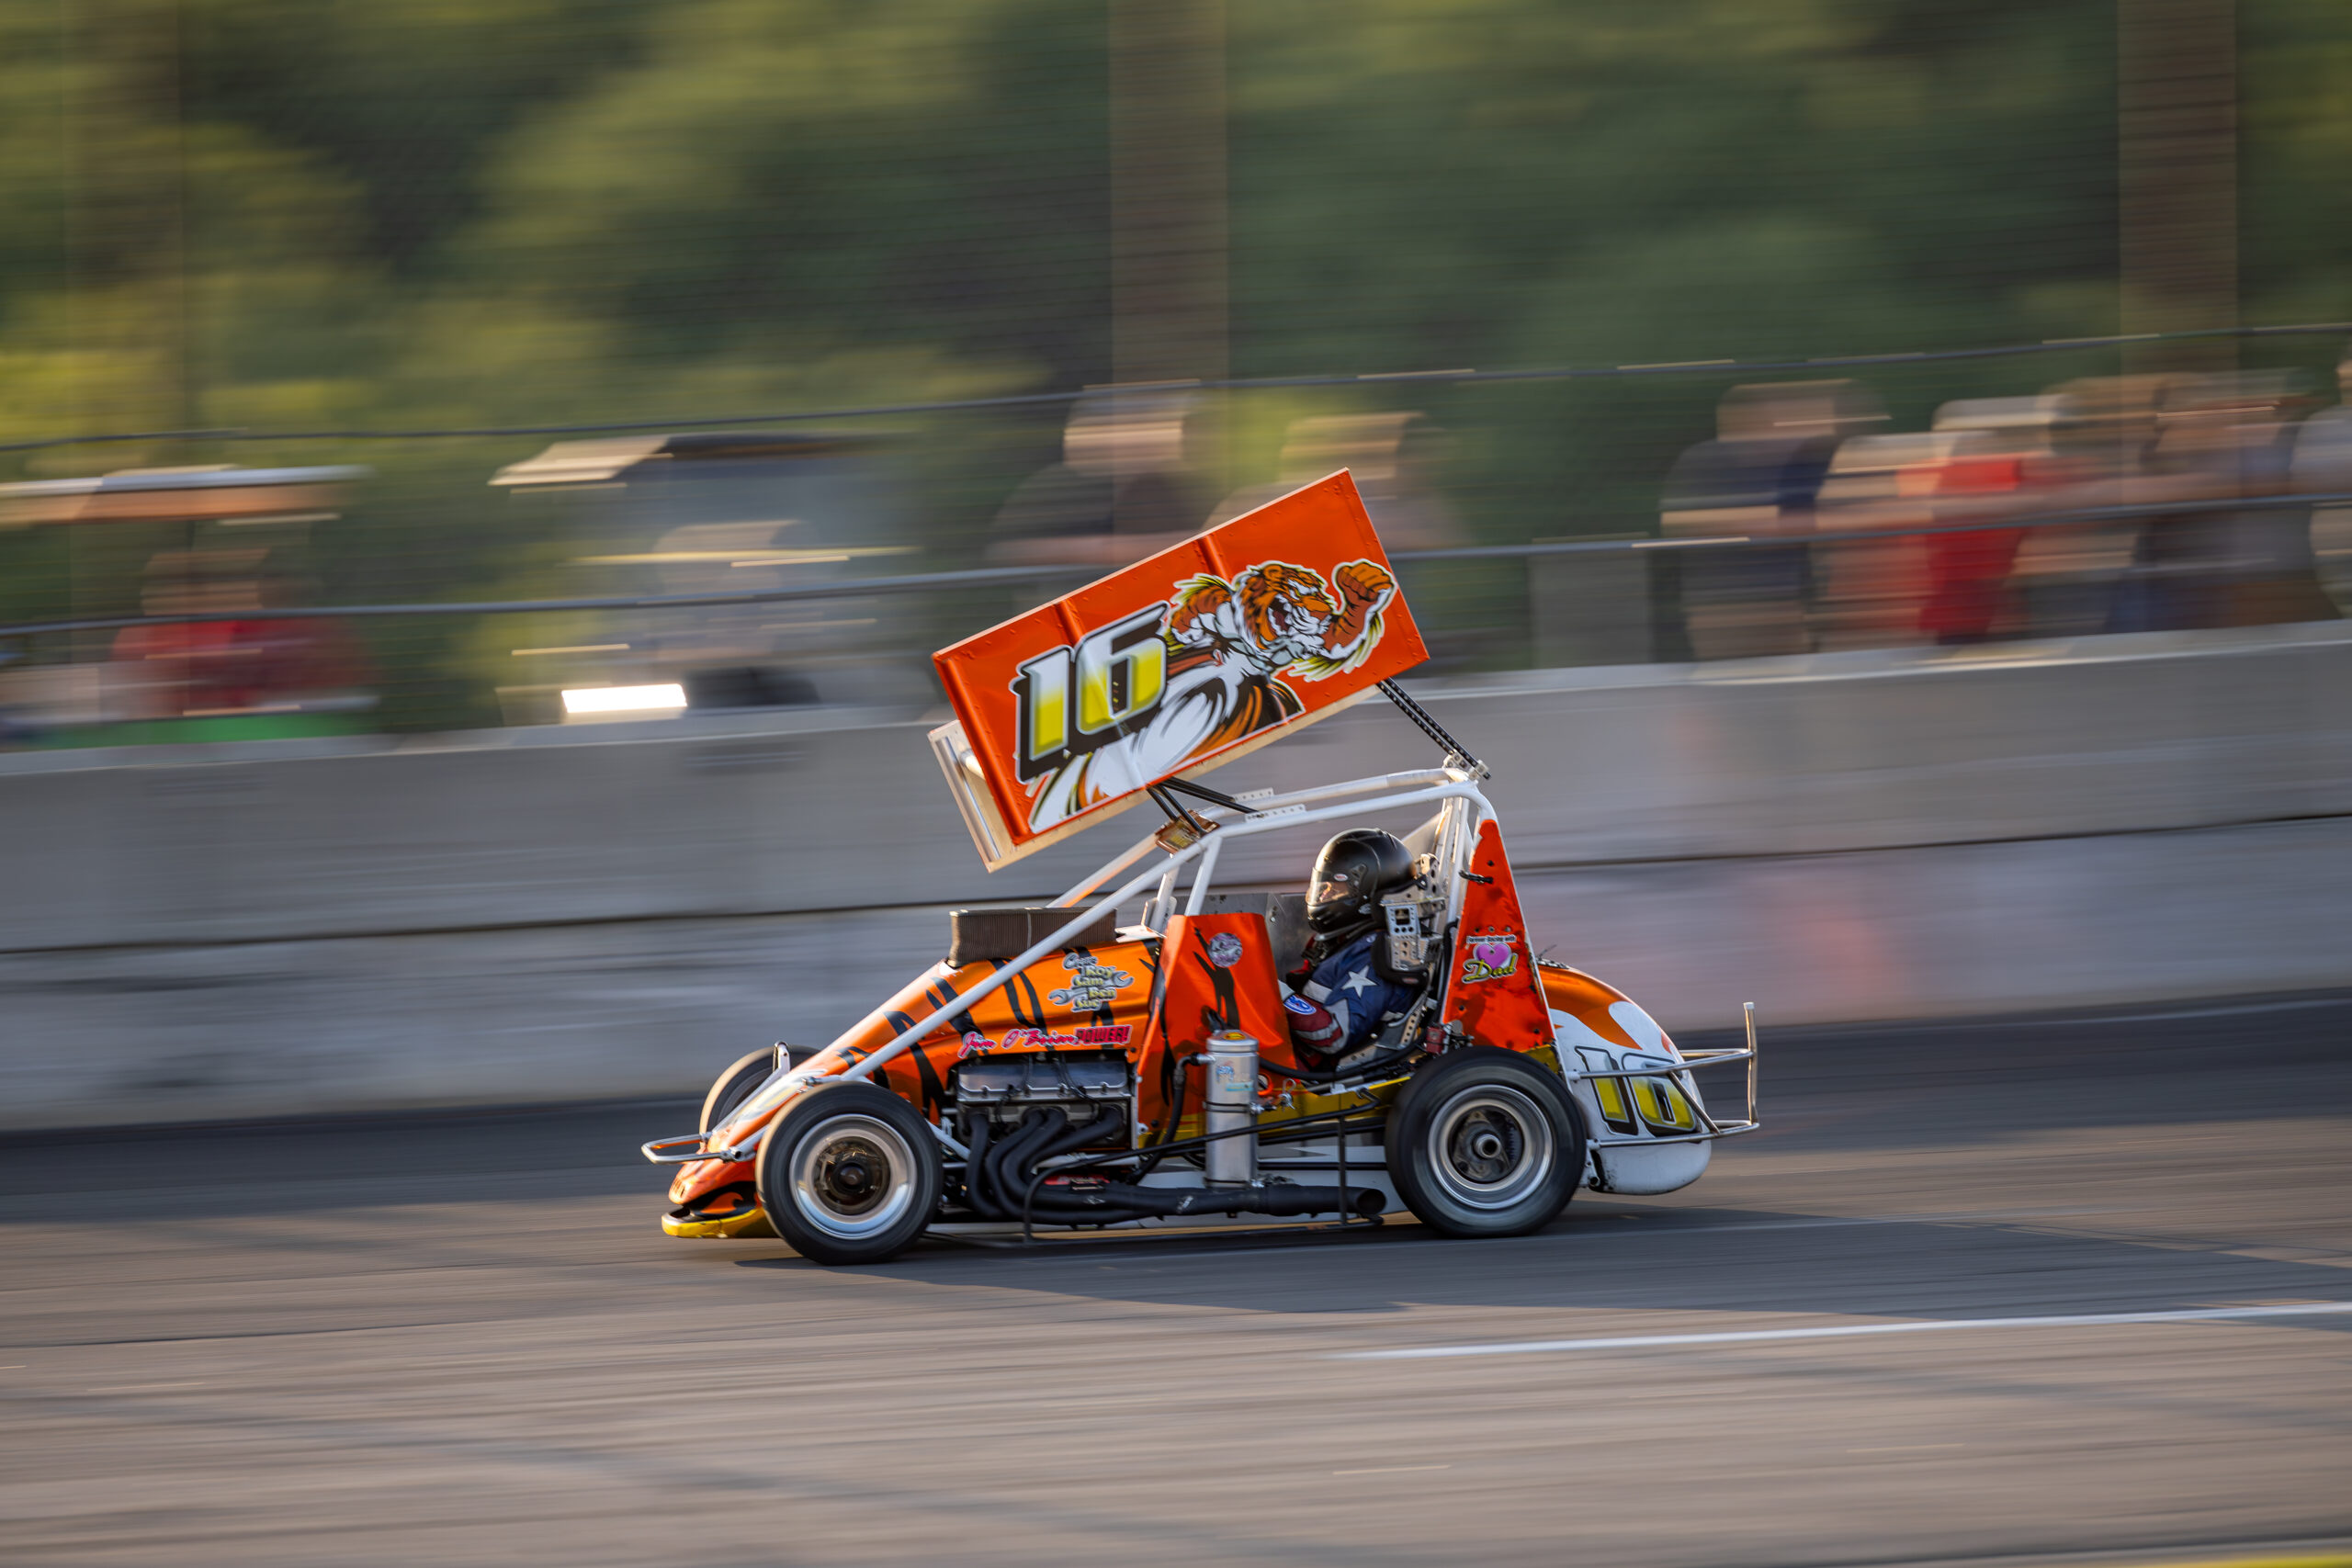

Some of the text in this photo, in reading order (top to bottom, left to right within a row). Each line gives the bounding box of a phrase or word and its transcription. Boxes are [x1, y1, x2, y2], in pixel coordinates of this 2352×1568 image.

[1013, 603, 1167, 779] 16
[1082, 964, 1115, 979] Roy
[1464, 953, 1517, 982] Dad
[1072, 975, 1105, 987] Sam
[1088, 987, 1115, 999] Ben
